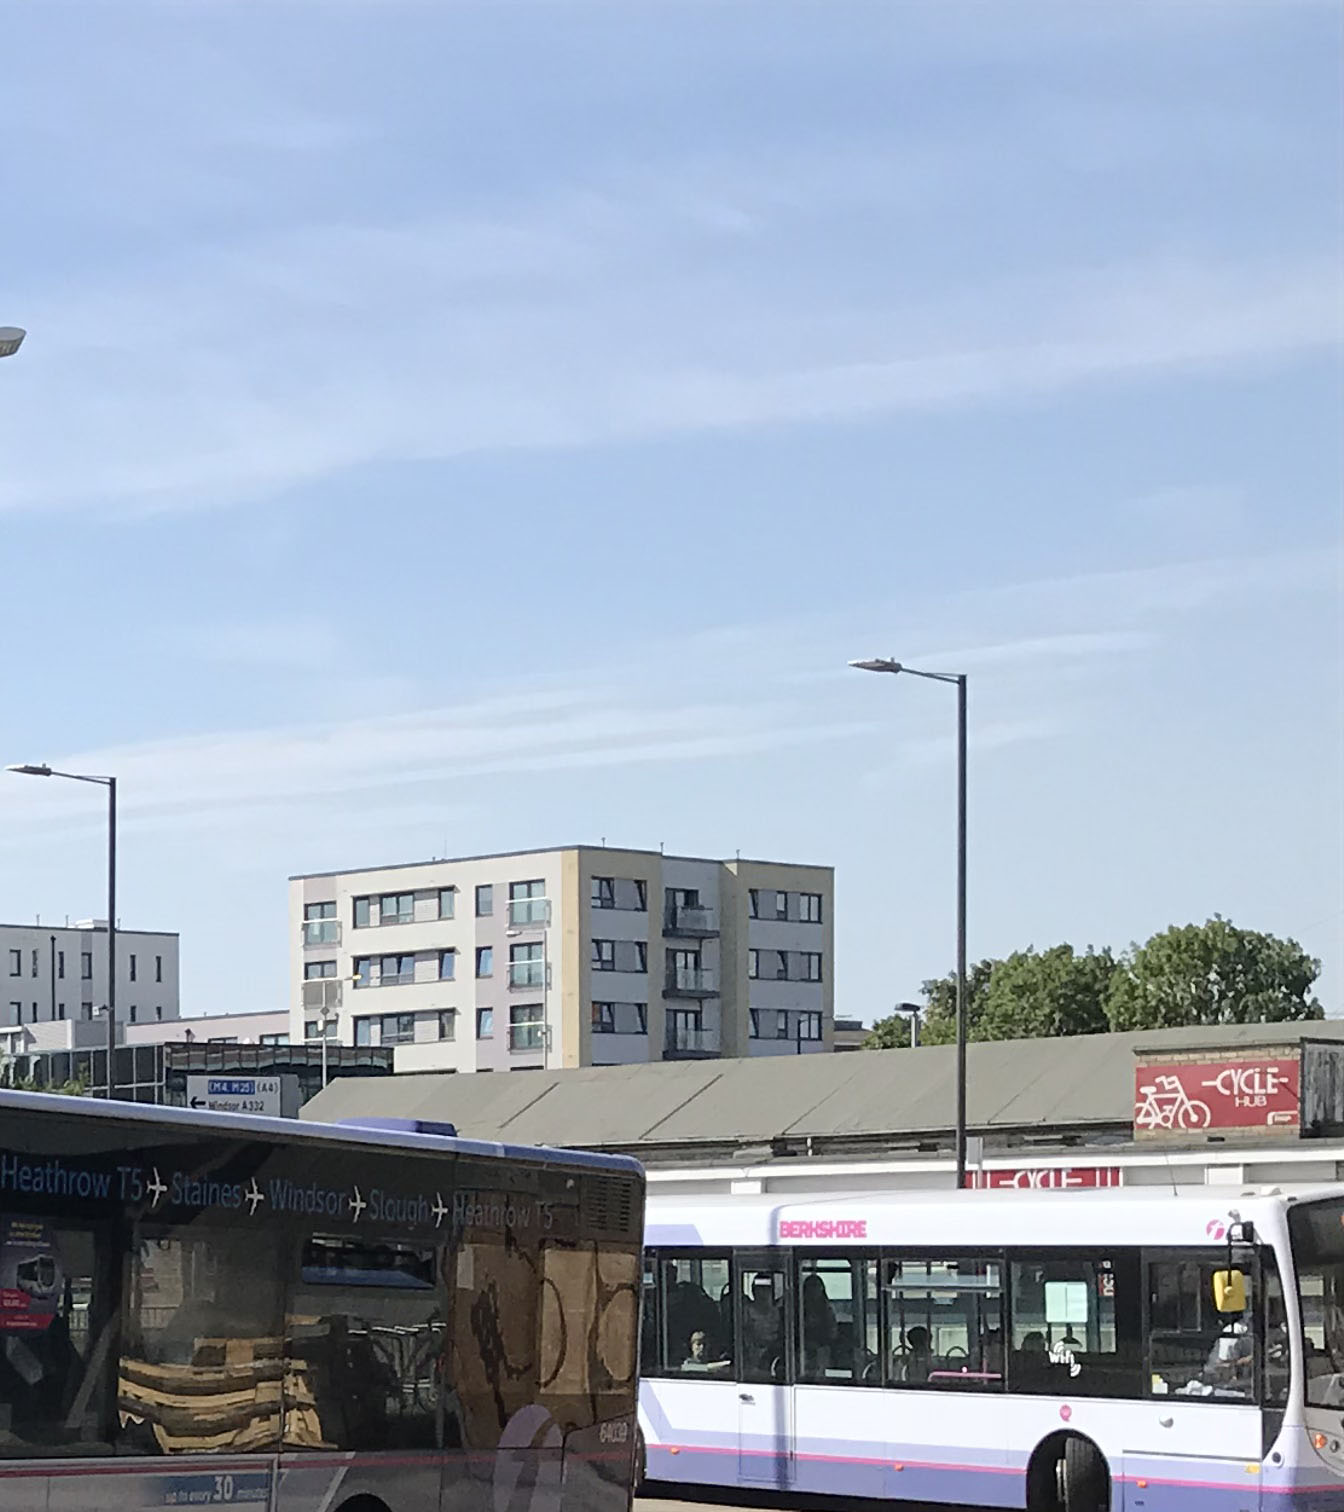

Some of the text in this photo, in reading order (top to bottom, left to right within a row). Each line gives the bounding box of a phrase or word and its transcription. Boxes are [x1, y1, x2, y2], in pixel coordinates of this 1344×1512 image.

[1214, 1067, 1281, 1096] CYCLE
[242, 1100, 265, 1111] A332
[1234, 1095, 1267, 1108] HUB
[0, 1155, 111, 1200] Heathrow
[117, 1165, 143, 1201] T5
[171, 1171, 242, 1208] Staines
[269, 1178, 346, 1215] Windsor
[368, 1188, 429, 1226] Slough
[452, 1190, 530, 1228] Heathrow
[780, 1220, 867, 1239] BERKSHIRE
[213, 1475, 233, 1501] 30
